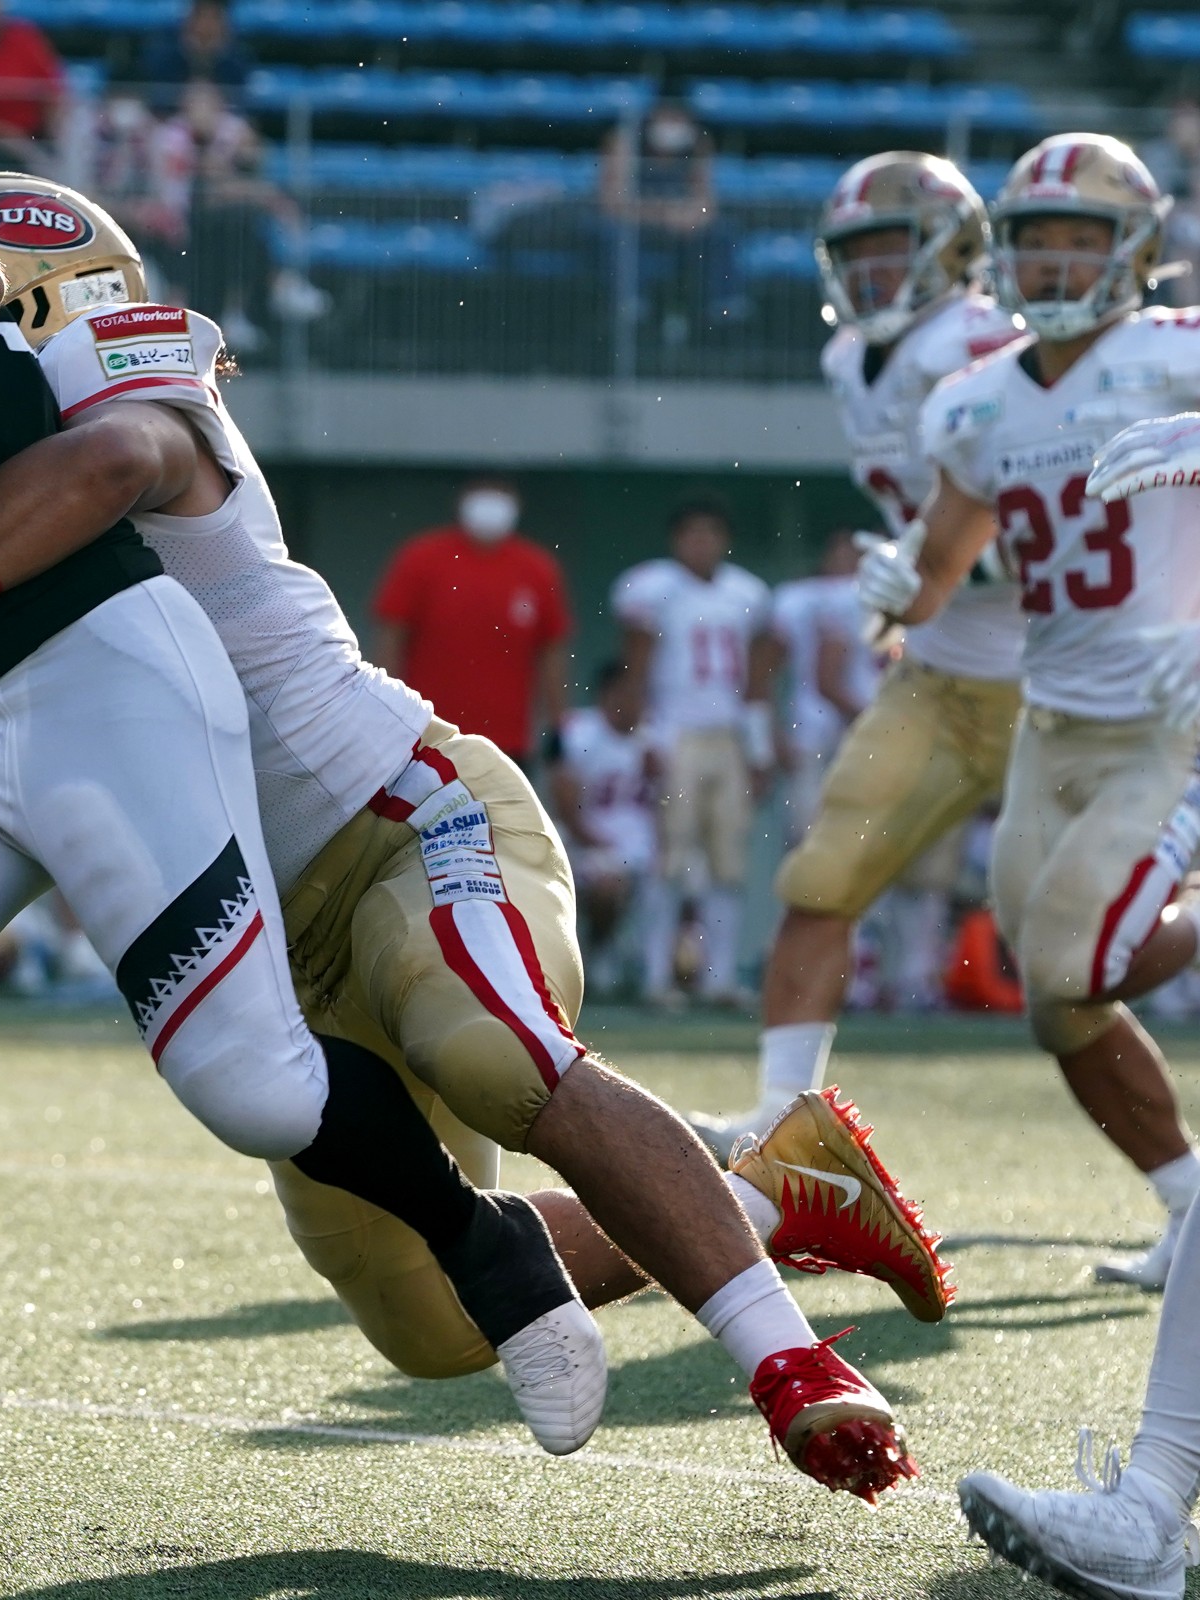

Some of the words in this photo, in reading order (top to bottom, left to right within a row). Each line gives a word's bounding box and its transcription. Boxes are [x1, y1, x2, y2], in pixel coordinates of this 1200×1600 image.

[93, 309, 184, 329] TOTALWorkout
[998, 470, 1136, 616] 23
[468, 886, 501, 895] GROUP
